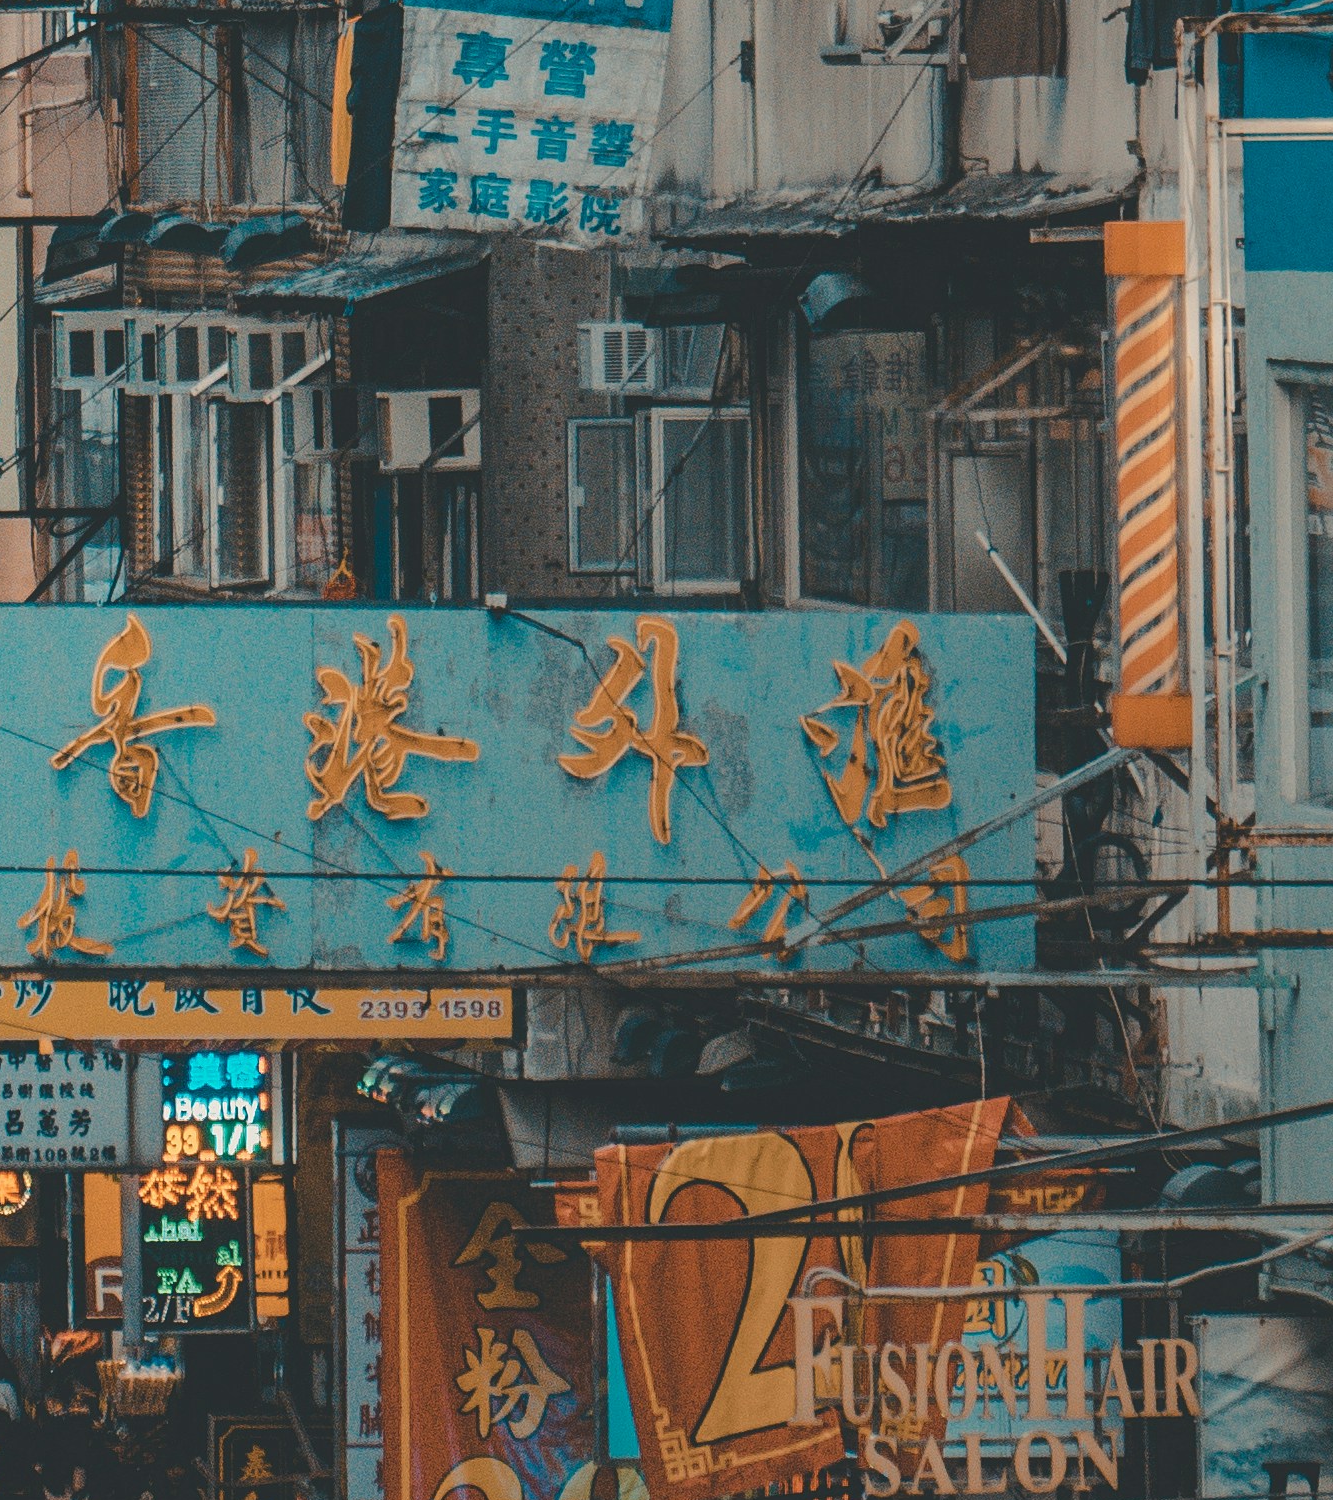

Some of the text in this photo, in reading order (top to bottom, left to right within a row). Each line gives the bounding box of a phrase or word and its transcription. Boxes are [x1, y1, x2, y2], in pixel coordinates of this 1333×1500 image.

[452, 31, 598, 98] 專營
[418, 105, 634, 168] 二手音響
[418, 167, 623, 236] 家庭影院
[359, 998, 503, 1021] 2393 1598
[174, 1092, 260, 1125] Beauty
[863, 1428, 1121, 1498] SALON
